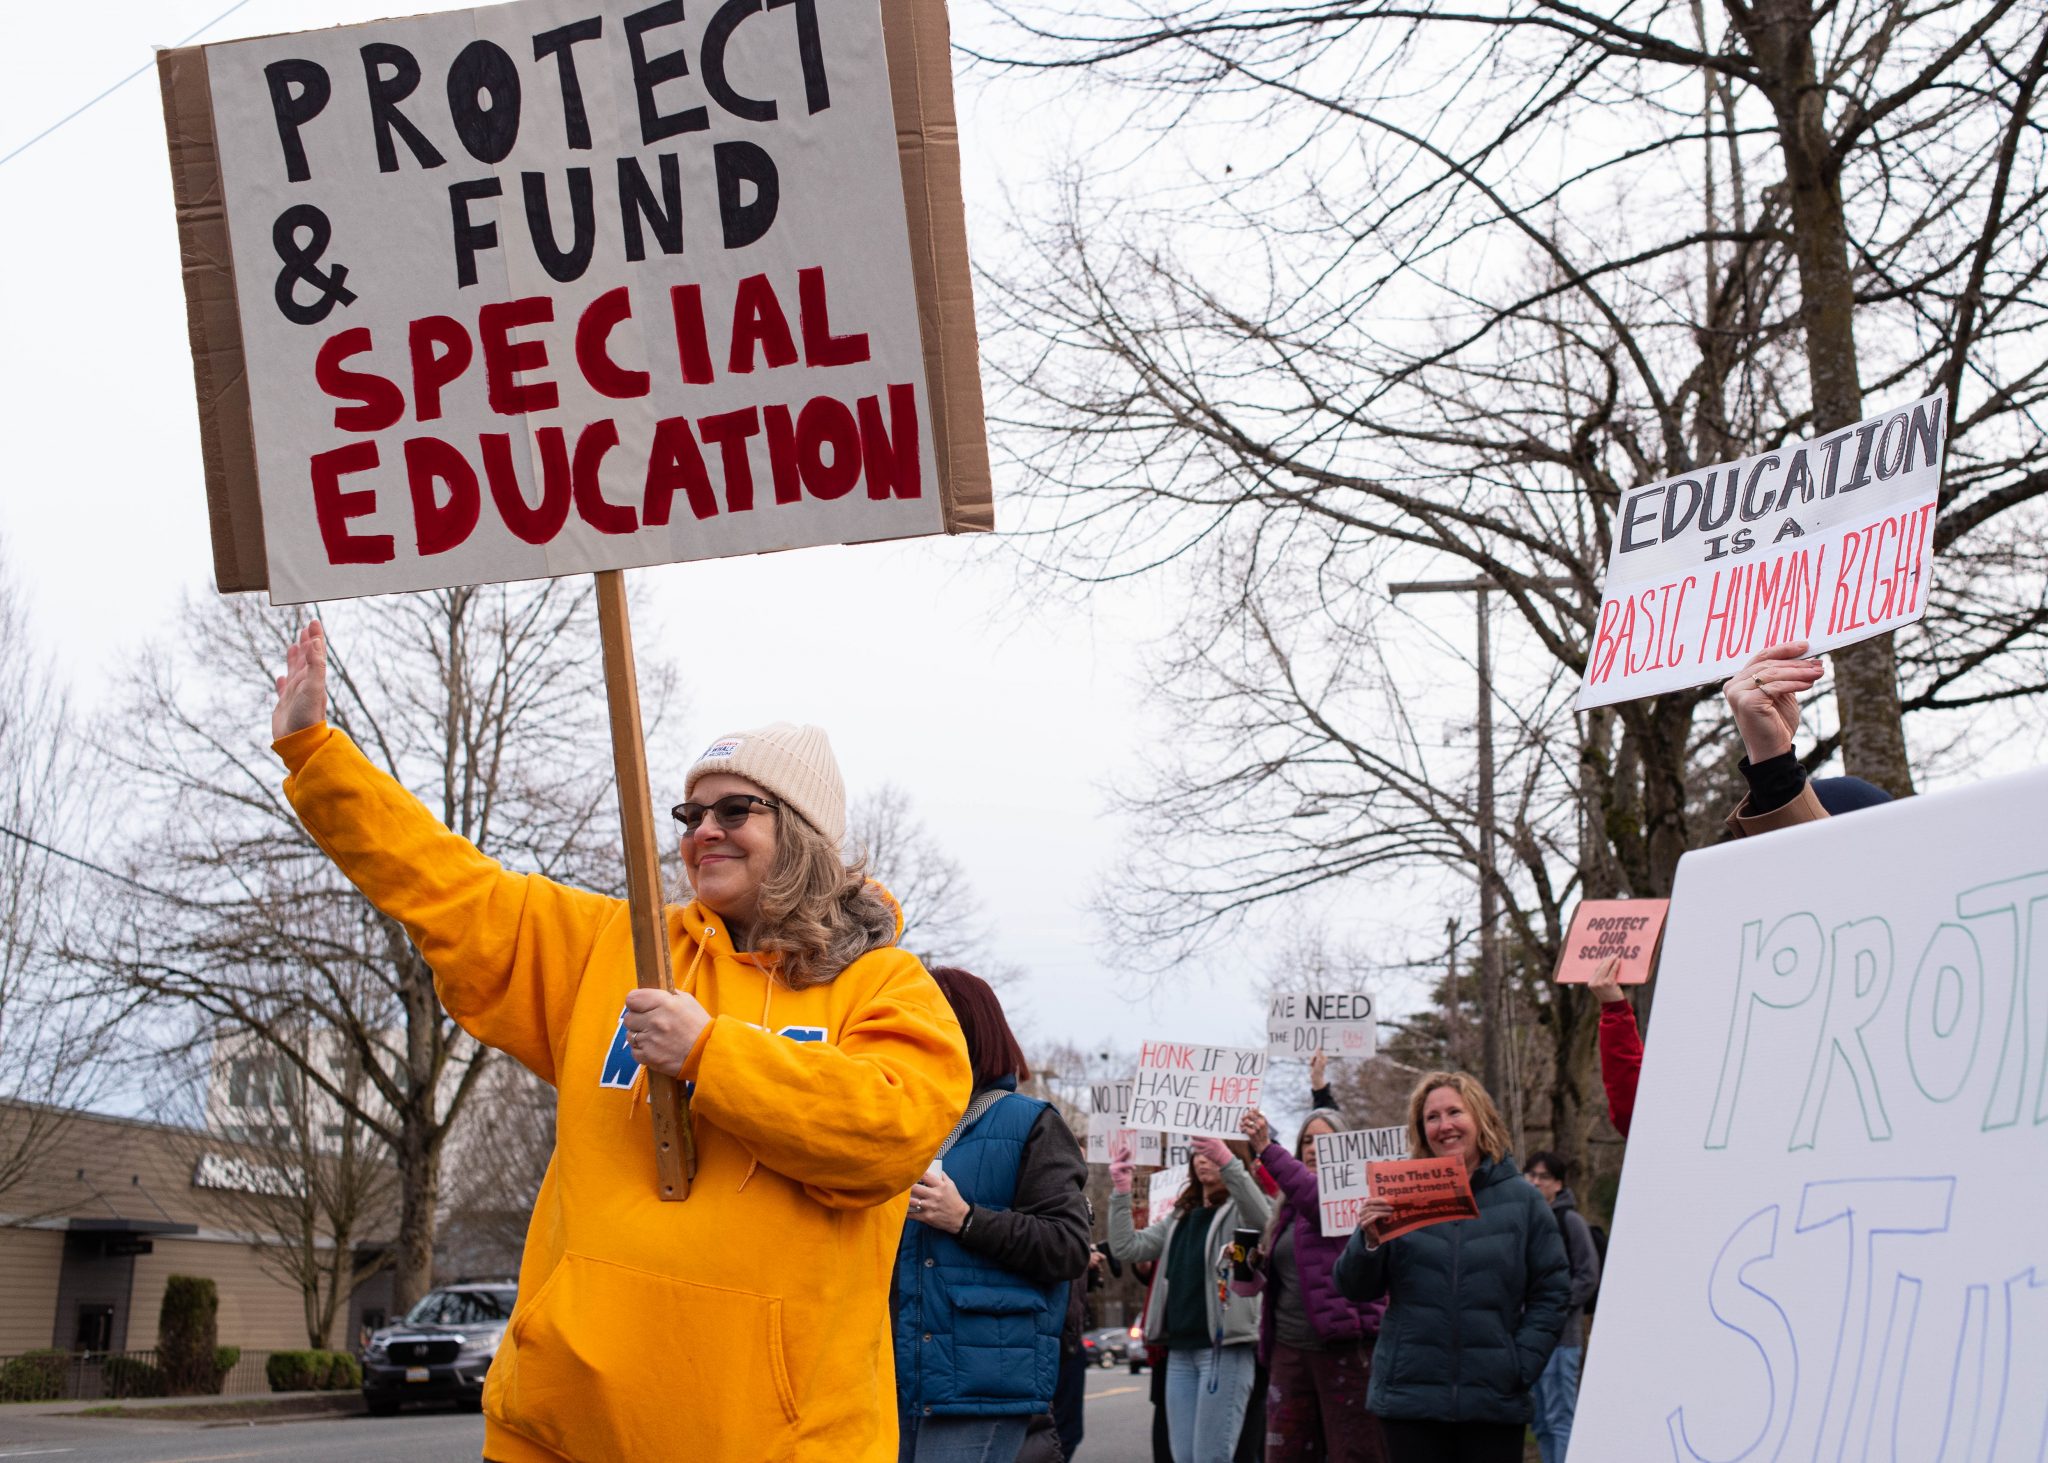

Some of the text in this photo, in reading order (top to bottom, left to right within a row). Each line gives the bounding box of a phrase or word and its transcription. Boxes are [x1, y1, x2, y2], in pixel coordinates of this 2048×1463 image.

[264, 0, 831, 183] PROTECT
[271, 140, 780, 326] & FUND
[315, 266, 871, 433] SPECIAL
[309, 383, 922, 566] EDUCATION
[1619, 398, 1943, 554] EDUCATION
[1704, 517, 1805, 562] IS A
[1590, 502, 1937, 686] BASIC HUMAN RIGHT
[1586, 916, 1649, 931] PROTECT
[1598, 931, 1627, 945] OUR
[1579, 945, 1641, 960] SCHOOLS
[1305, 994, 1371, 1020] NEED
[1704, 870, 2048, 1152] PROT
[1269, 1031, 1288, 1044] THE
[1140, 1042, 1265, 1076] HONK IF YOU
[1090, 1085, 1111, 1114] NO
[1137, 1072, 1260, 1104] HAVE HOPE
[1131, 1098, 1258, 1134] FOR EDUCATI
[1320, 1163, 1358, 1194] THE
[1375, 1167, 1459, 1184] Save The U.S.
[1378, 1180, 1459, 1198] Department
[1321, 1197, 1367, 1230] TERR
